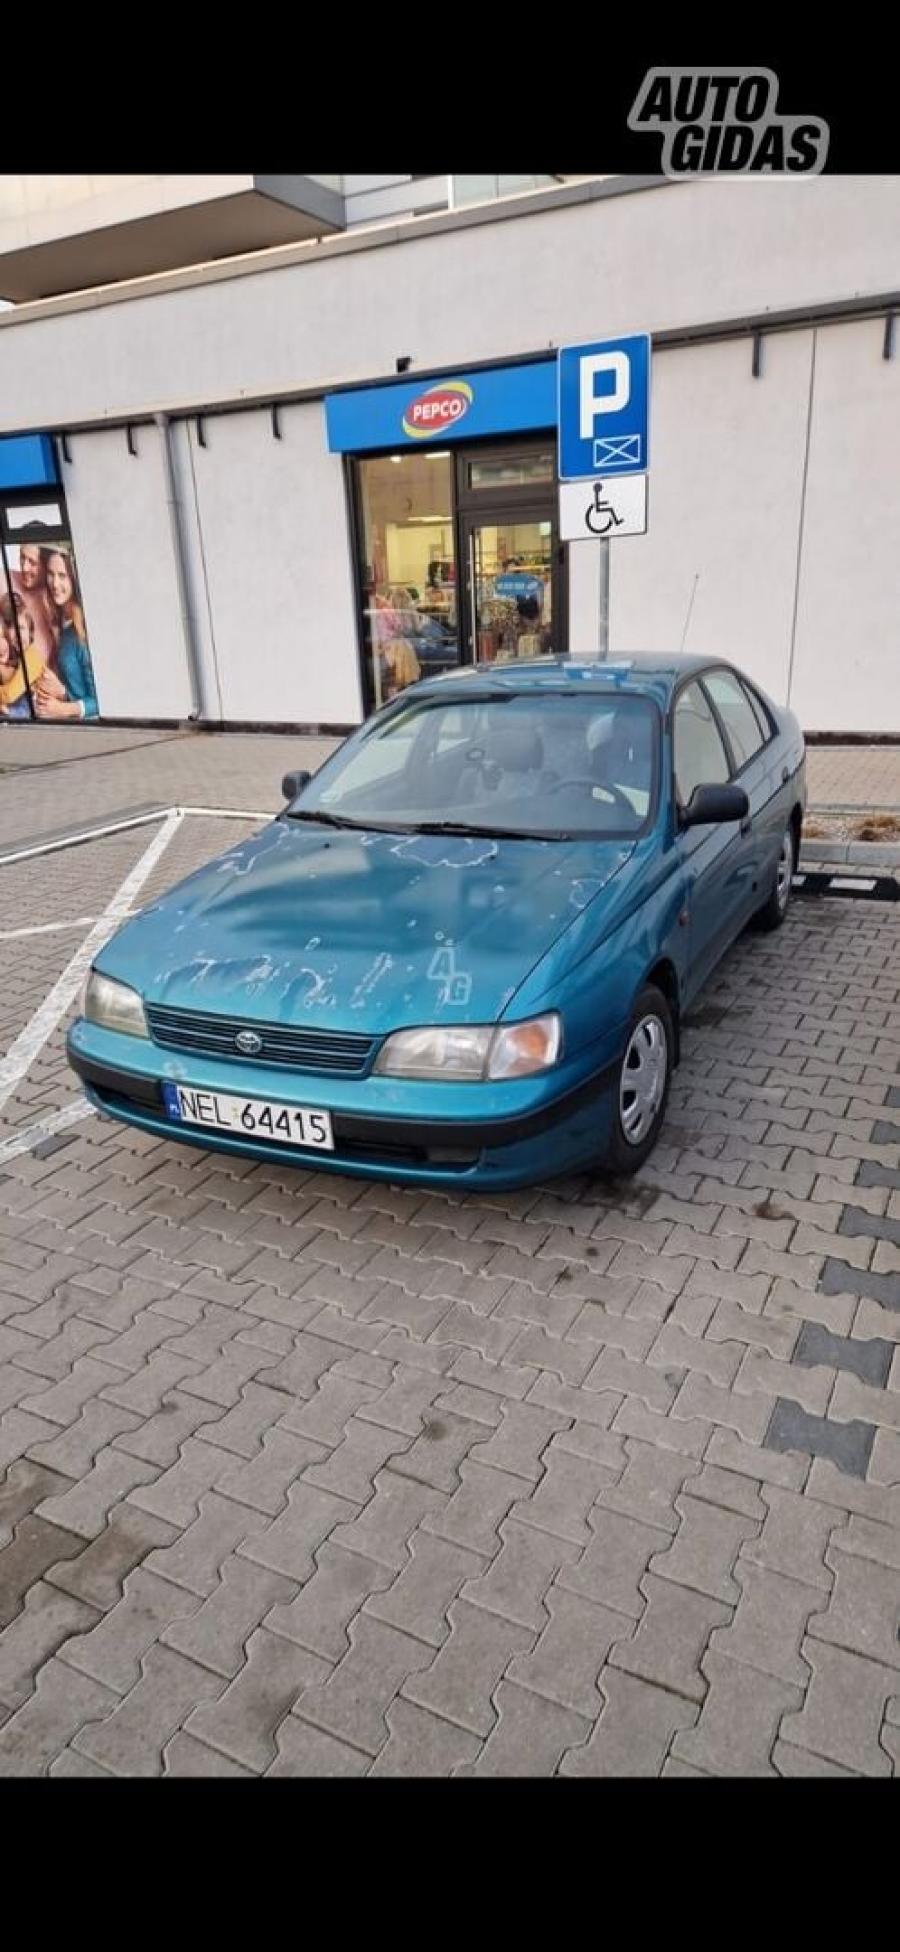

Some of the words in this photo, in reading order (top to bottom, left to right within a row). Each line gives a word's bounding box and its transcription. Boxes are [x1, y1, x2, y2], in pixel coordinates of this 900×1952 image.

[412, 399, 461, 422] PEPCO
[580, 351, 631, 440] P
[180, 1090, 232, 1126] NEL
[241, 1103, 327, 1143] 64415
